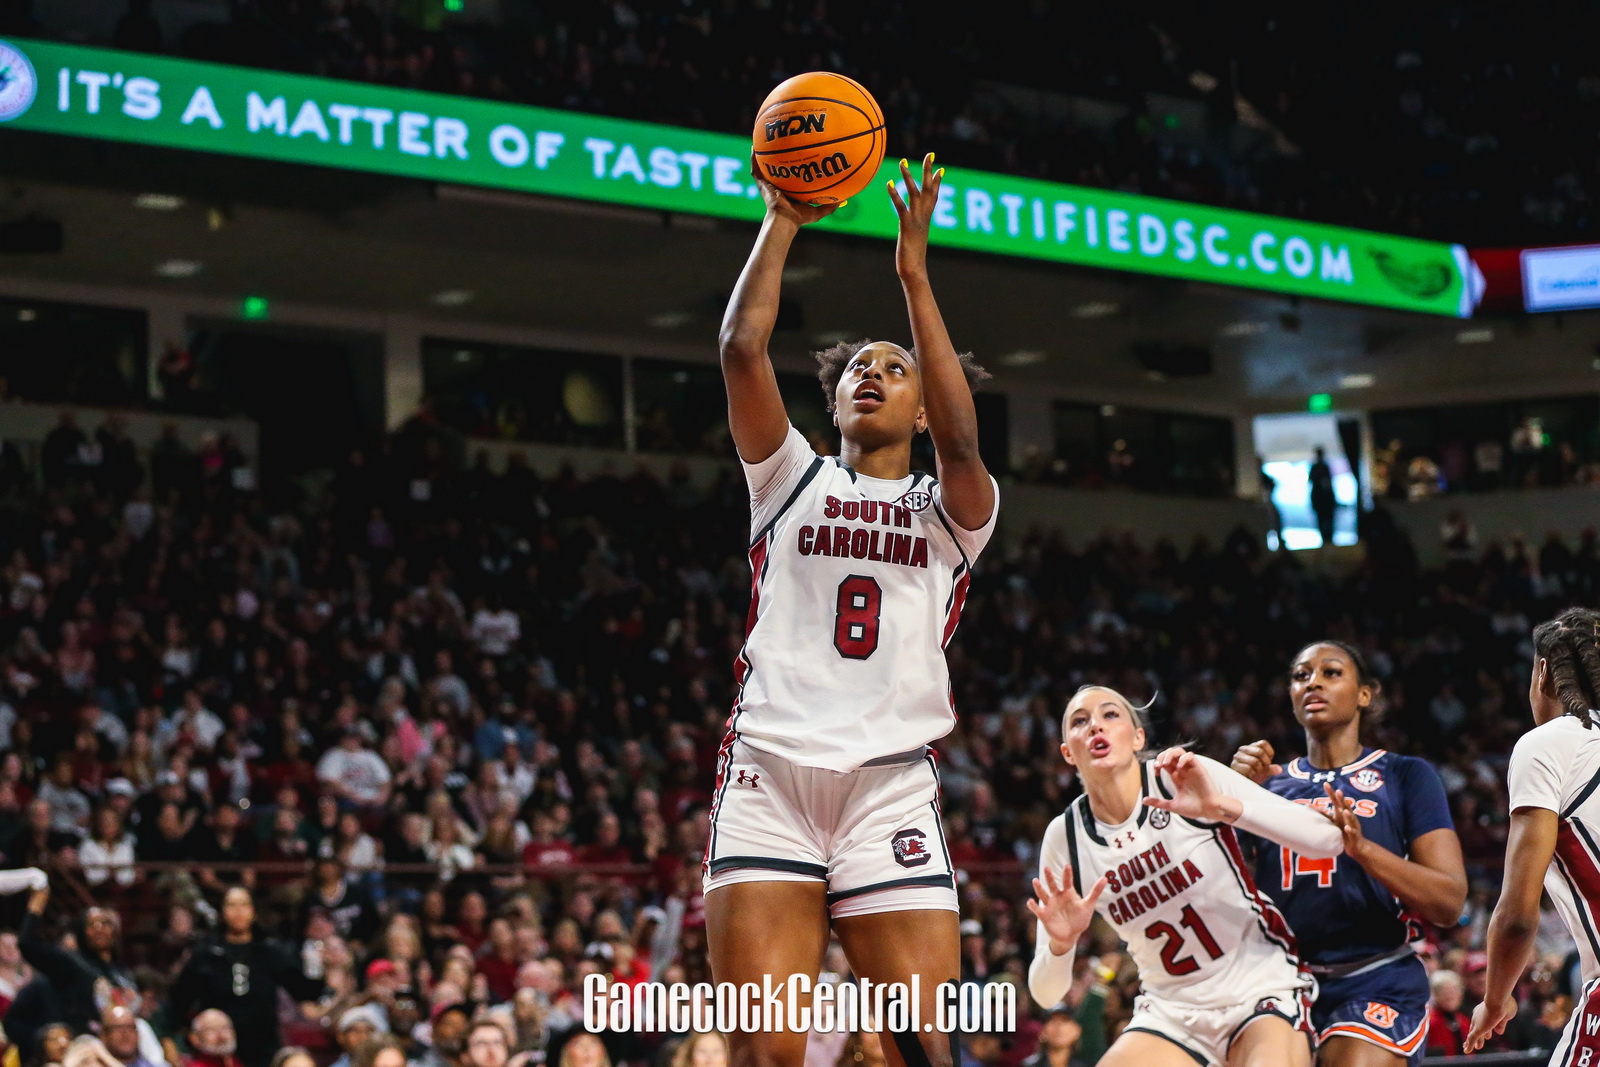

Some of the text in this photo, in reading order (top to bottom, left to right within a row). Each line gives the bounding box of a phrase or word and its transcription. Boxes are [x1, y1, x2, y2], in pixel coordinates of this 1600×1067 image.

[57, 67, 162, 120] IT'S
[181, 86, 224, 129] A
[246, 91, 469, 160] MATTER
[488, 124, 564, 170] OF
[583, 136, 759, 198] TASTE.
[765, 113, 827, 143] NCAA
[765, 152, 852, 183] Wilson
[824, 495, 912, 528] SOUTH
[902, 492, 932, 511] SEC
[798, 525, 928, 568] CAROLINA
[833, 574, 882, 660] 8
[1105, 841, 1171, 894] SOUTH
[1280, 843, 1337, 891] 14
[1108, 859, 1204, 926] CAROLINA
[1145, 903, 1225, 976] 21
